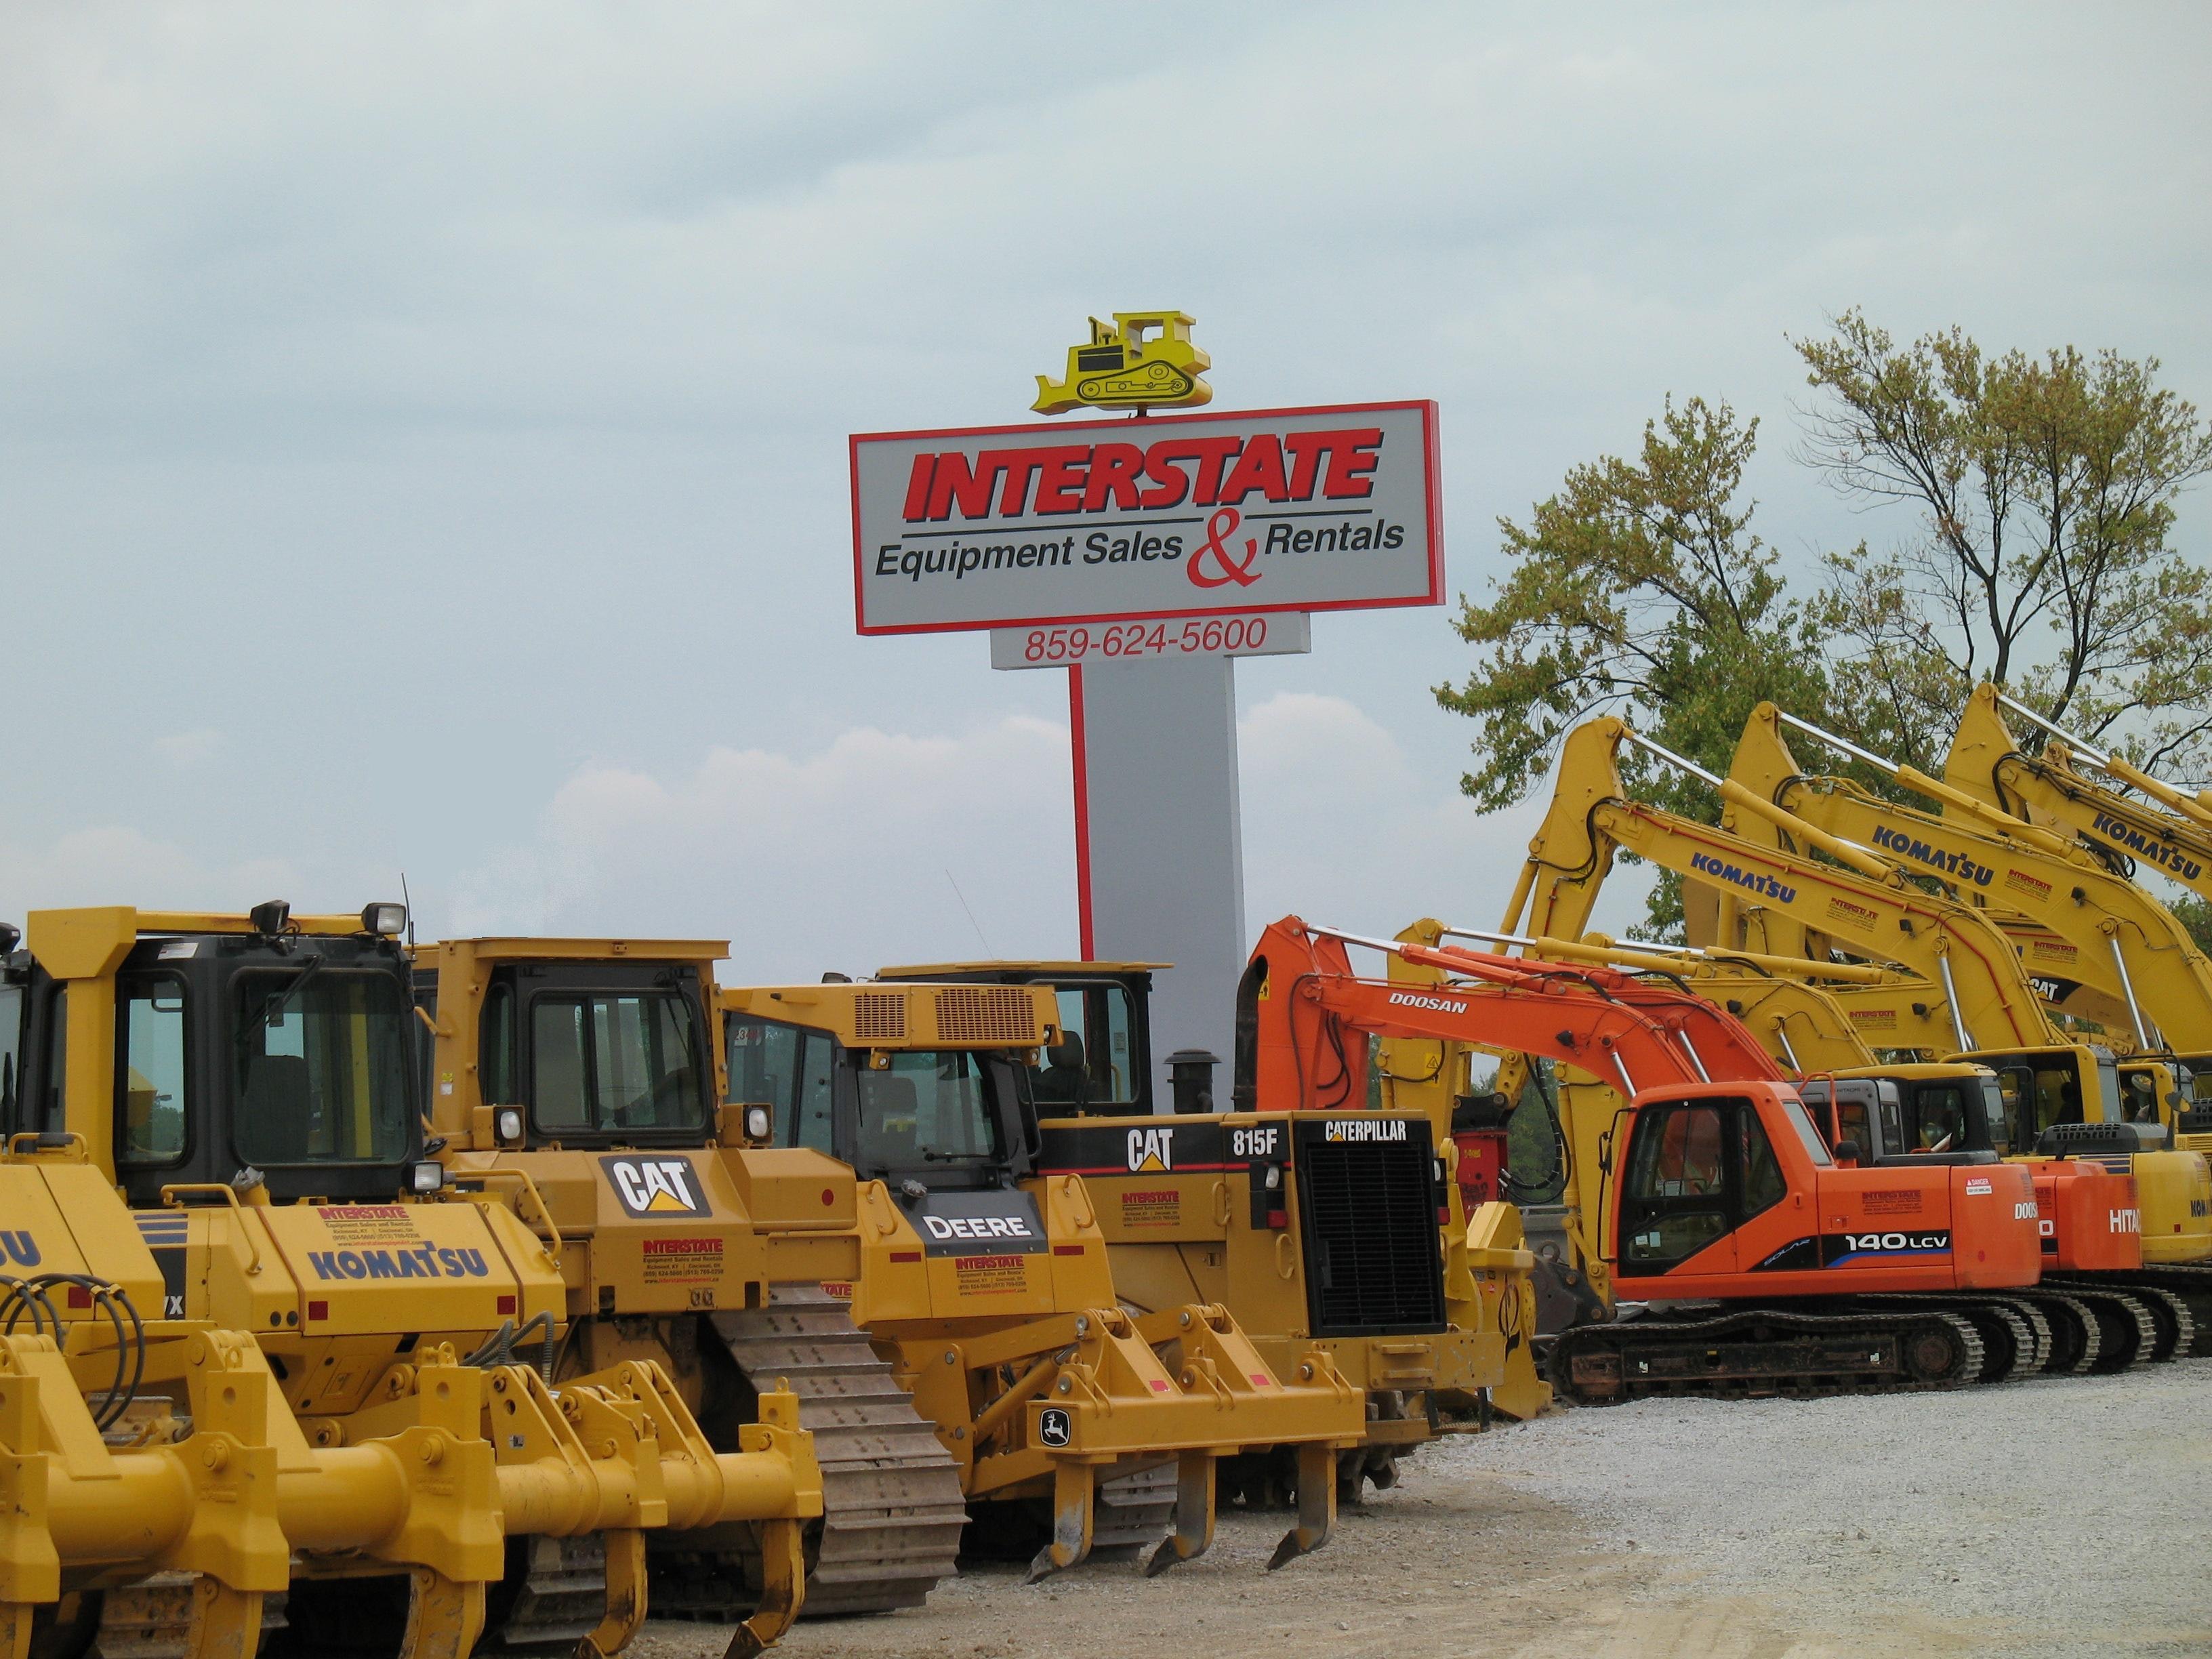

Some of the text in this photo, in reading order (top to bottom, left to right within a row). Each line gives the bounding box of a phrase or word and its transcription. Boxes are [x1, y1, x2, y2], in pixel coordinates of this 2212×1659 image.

[902, 428, 1385, 523] INTERSTATE
[876, 508, 1405, 588] Equipment Sales & Rentals
[1024, 617, 1267, 661] 859-624-5600
[1872, 825, 1994, 886] KOMATSU
[2092, 813, 2202, 880] KOMATSU
[1691, 852, 1796, 903] KOMATSU
[1389, 992, 1467, 1014] DOOSAN
[2030, 978, 2058, 1001] CAT
[1233, 1128, 1278, 1156] 815F
[1325, 1120, 1406, 1142] CATERPILLAR
[1128, 1129, 1174, 1171] CAT
[613, 1162, 697, 1211] CAT
[1122, 1191, 1180, 1204] INTERSTATE
[317, 1206, 409, 1219] INTERSTATE
[922, 1216, 1033, 1240] DEERE
[308, 1241, 489, 1279] KOMATSU
[643, 1238, 723, 1254] INTERSTATE
[955, 1255, 1024, 1269] INTERSTATE
